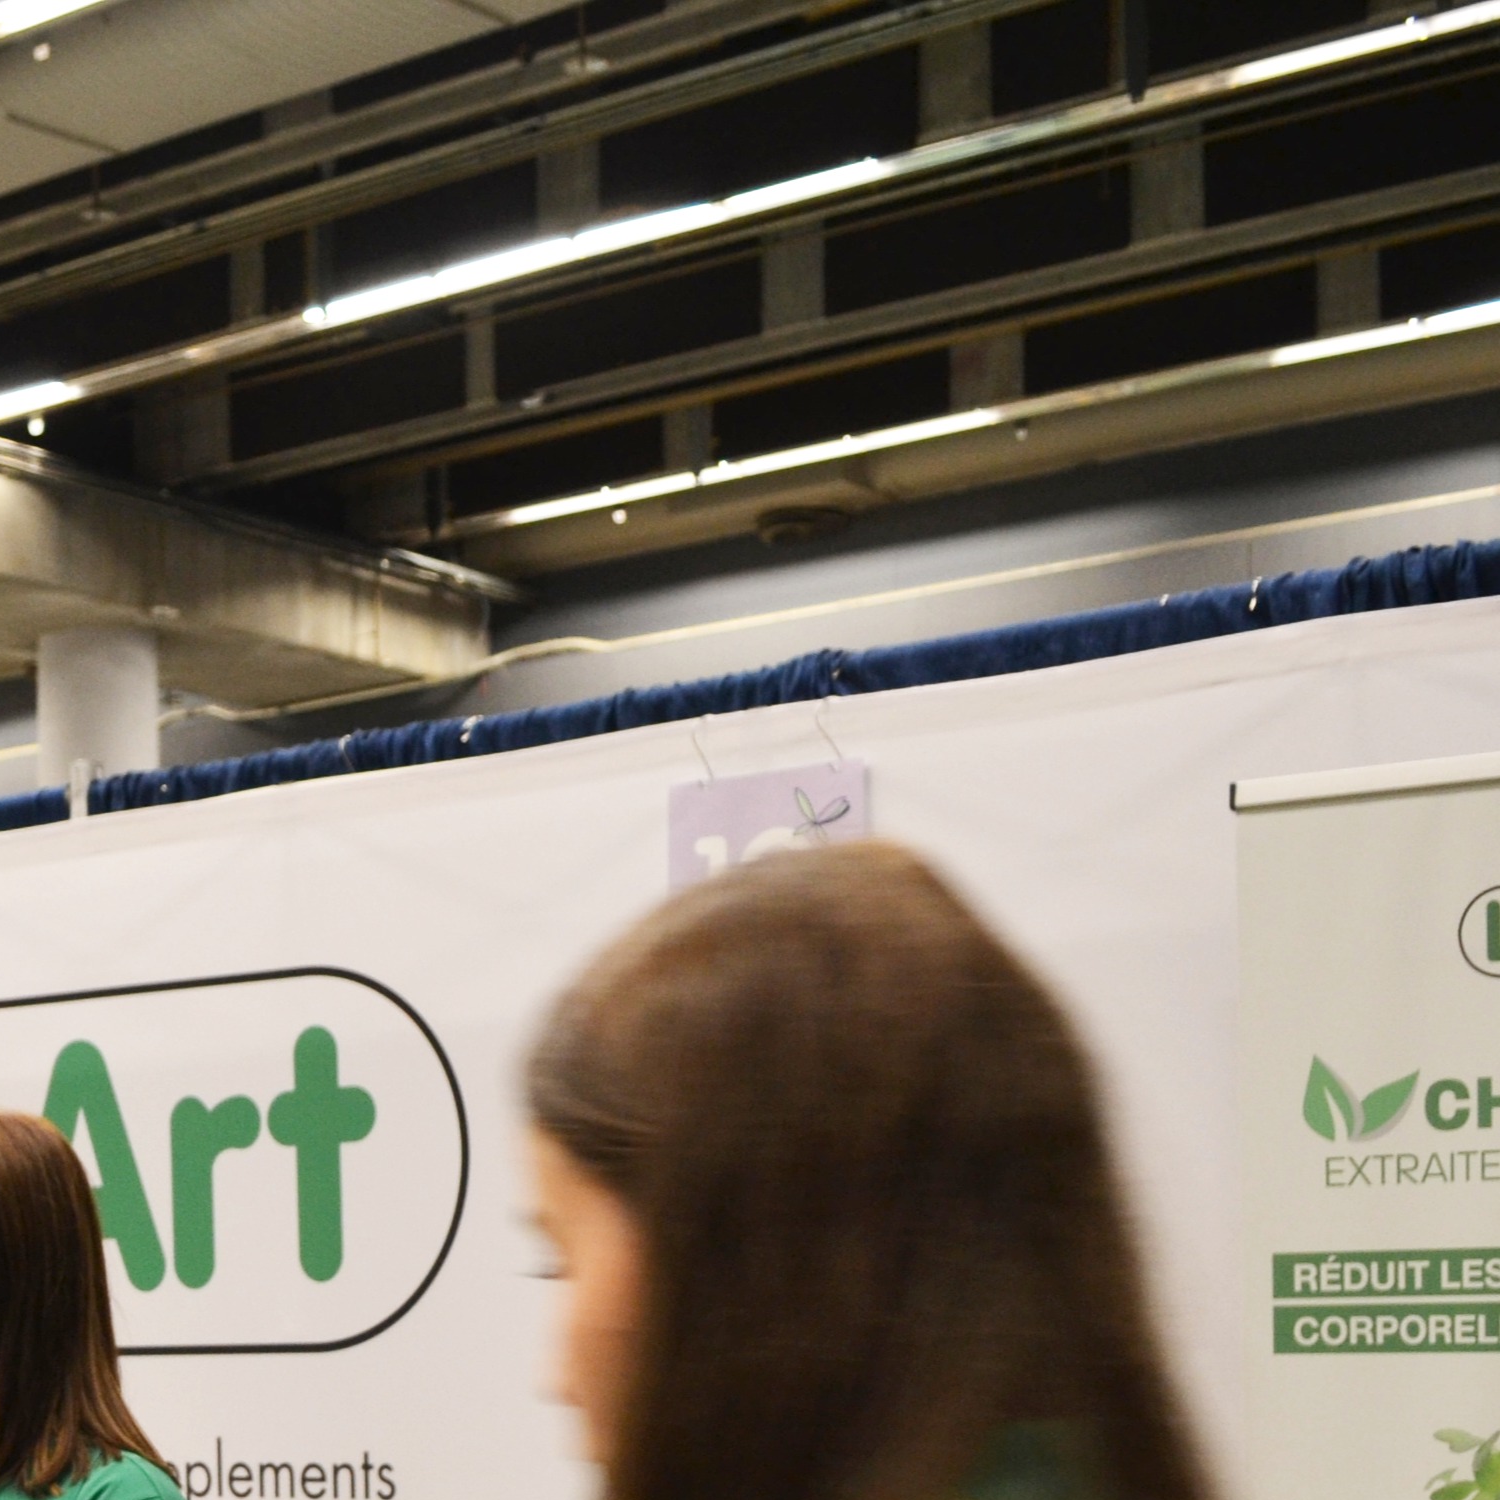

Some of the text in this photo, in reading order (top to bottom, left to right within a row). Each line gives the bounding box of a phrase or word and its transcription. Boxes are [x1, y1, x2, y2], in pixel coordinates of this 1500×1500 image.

[41, 1025, 376, 1291] Art
[1293, 1254, 1500, 1293] RÉDUIT LES
